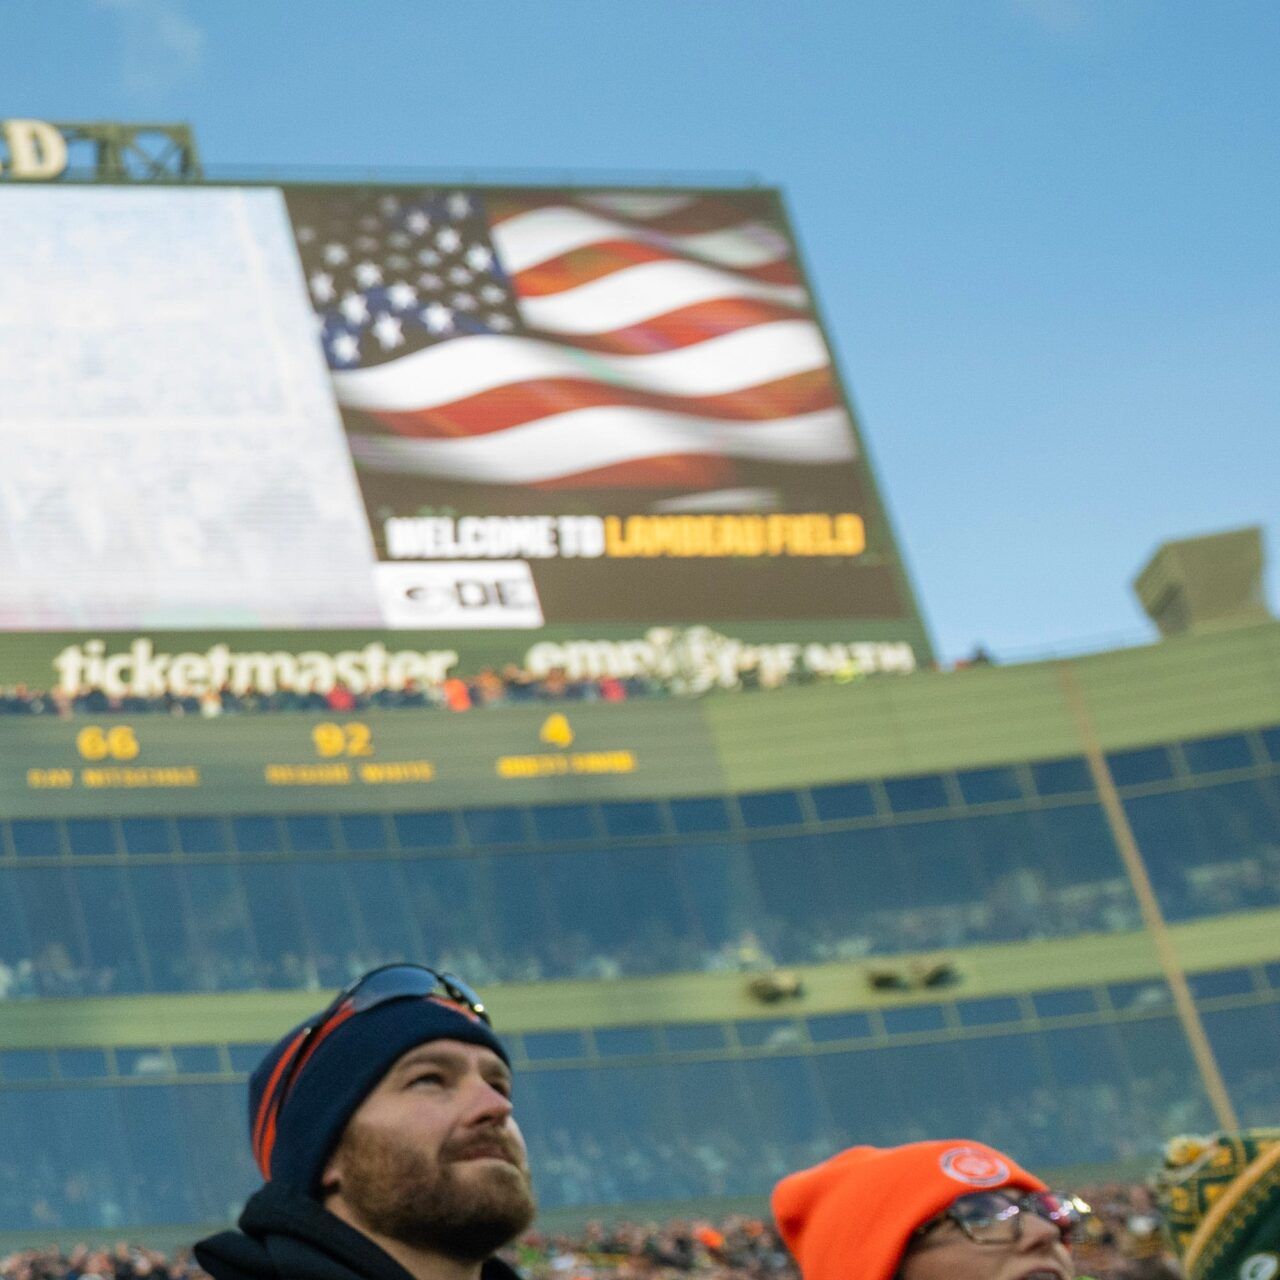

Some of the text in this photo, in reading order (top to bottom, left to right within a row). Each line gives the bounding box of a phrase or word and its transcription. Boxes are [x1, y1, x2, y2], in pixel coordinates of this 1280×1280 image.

[384, 513, 865, 558] WELCOME TO LAMBEAU FIELD
[53, 637, 459, 698] ticketmaster
[75, 724, 140, 761] 66
[312, 721, 373, 758] 92
[541, 712, 574, 748] 4
